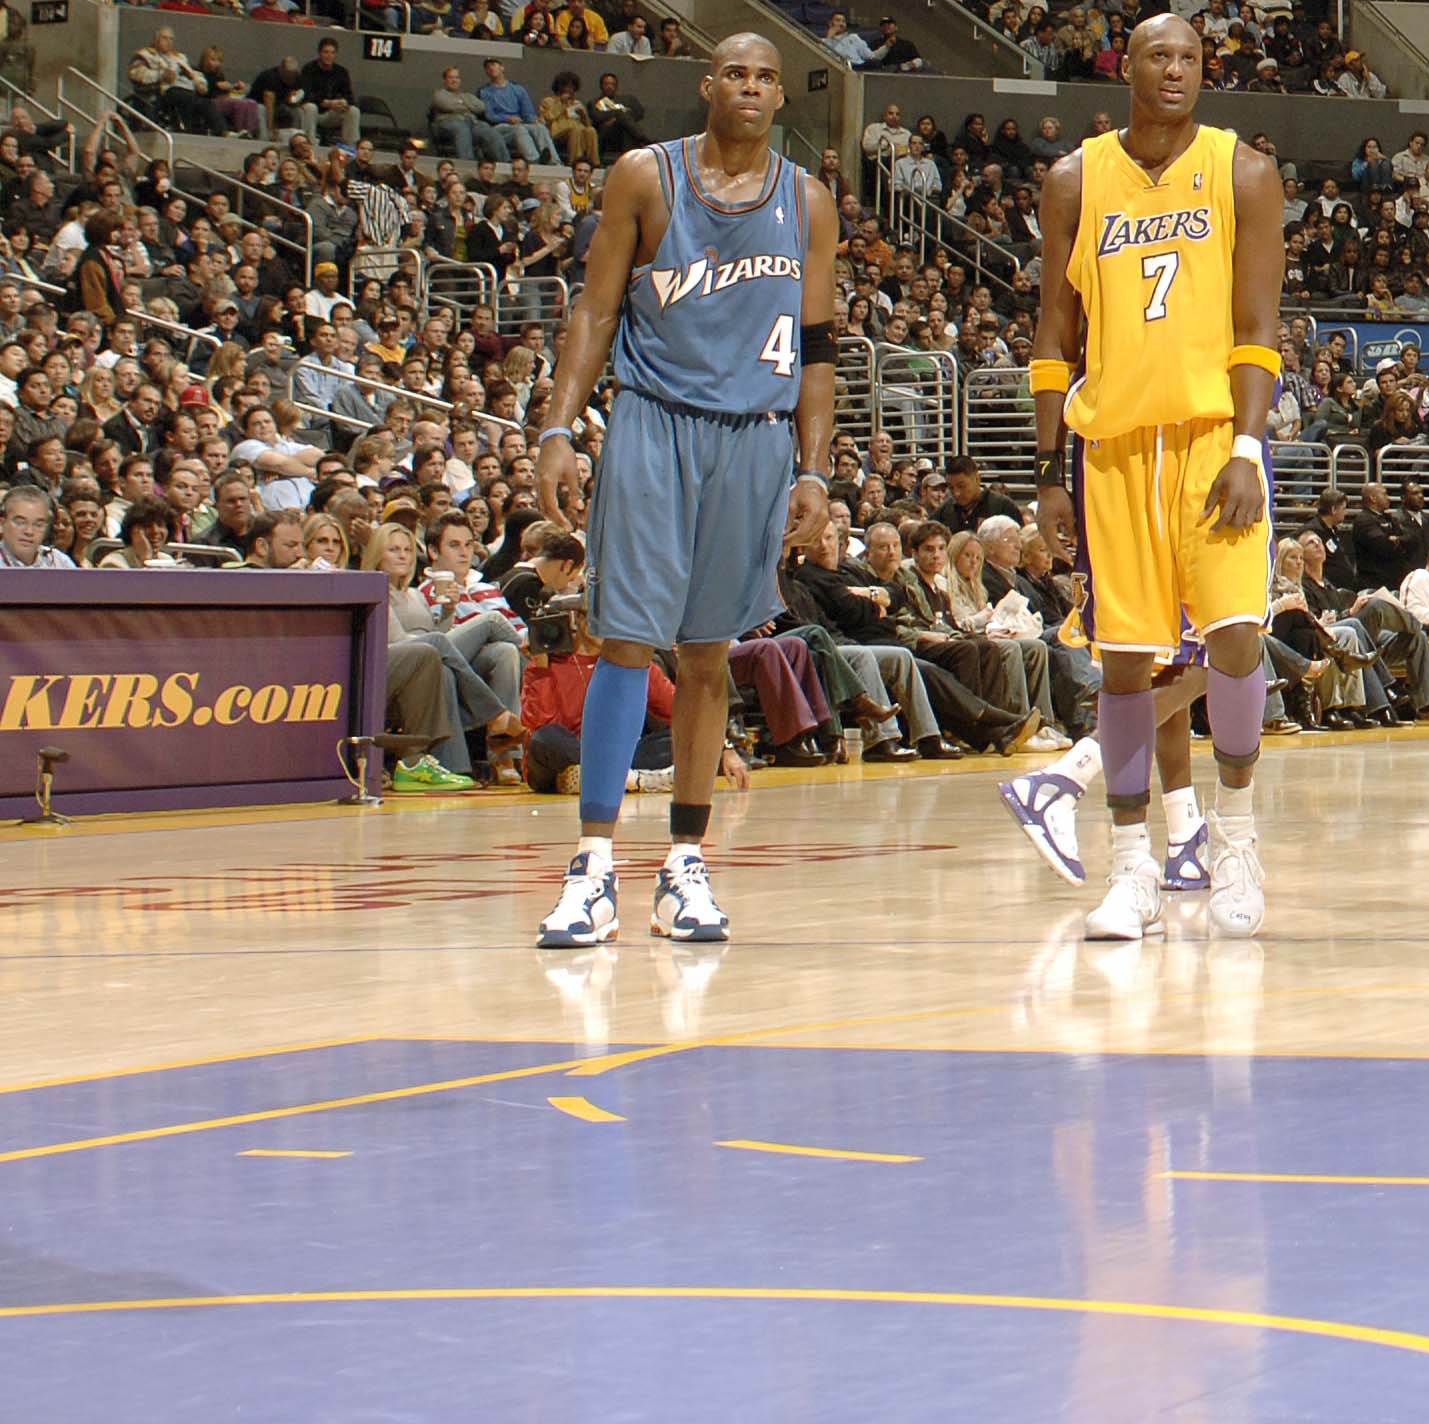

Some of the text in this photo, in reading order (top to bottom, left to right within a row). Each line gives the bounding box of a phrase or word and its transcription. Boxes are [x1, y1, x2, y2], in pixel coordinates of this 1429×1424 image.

[370, 37, 393, 59] 114
[1098, 208, 1211, 258] LAKERS
[651, 255, 801, 308] WIZARDS
[1141, 251, 1179, 322] 7
[759, 313, 798, 377] 4
[1367, 344, 1400, 357] SB
[0, 672, 342, 731] KERS.com
